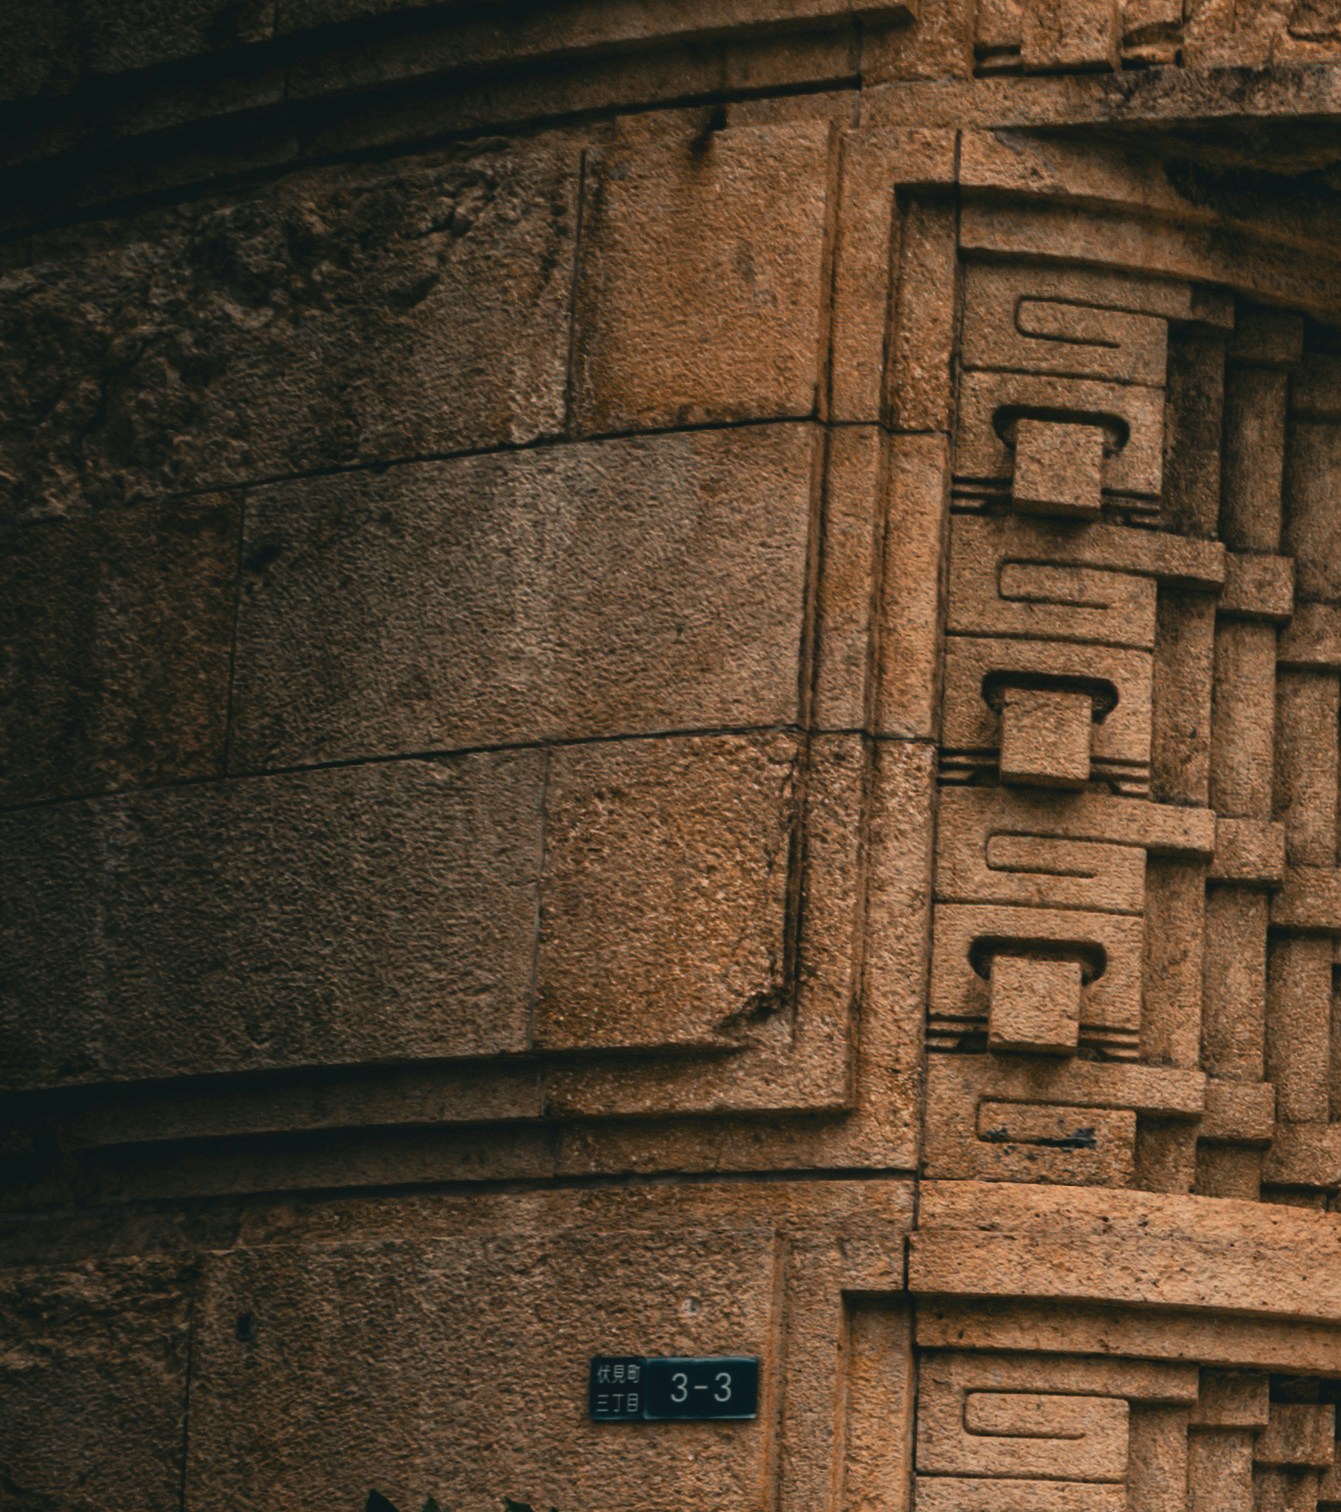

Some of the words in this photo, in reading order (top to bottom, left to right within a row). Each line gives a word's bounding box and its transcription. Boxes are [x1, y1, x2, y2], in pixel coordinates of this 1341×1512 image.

[597, 1364, 641, 1384] 伏見町
[670, 1372, 733, 1403] 3-3
[596, 1393, 639, 1413] 三丁目
